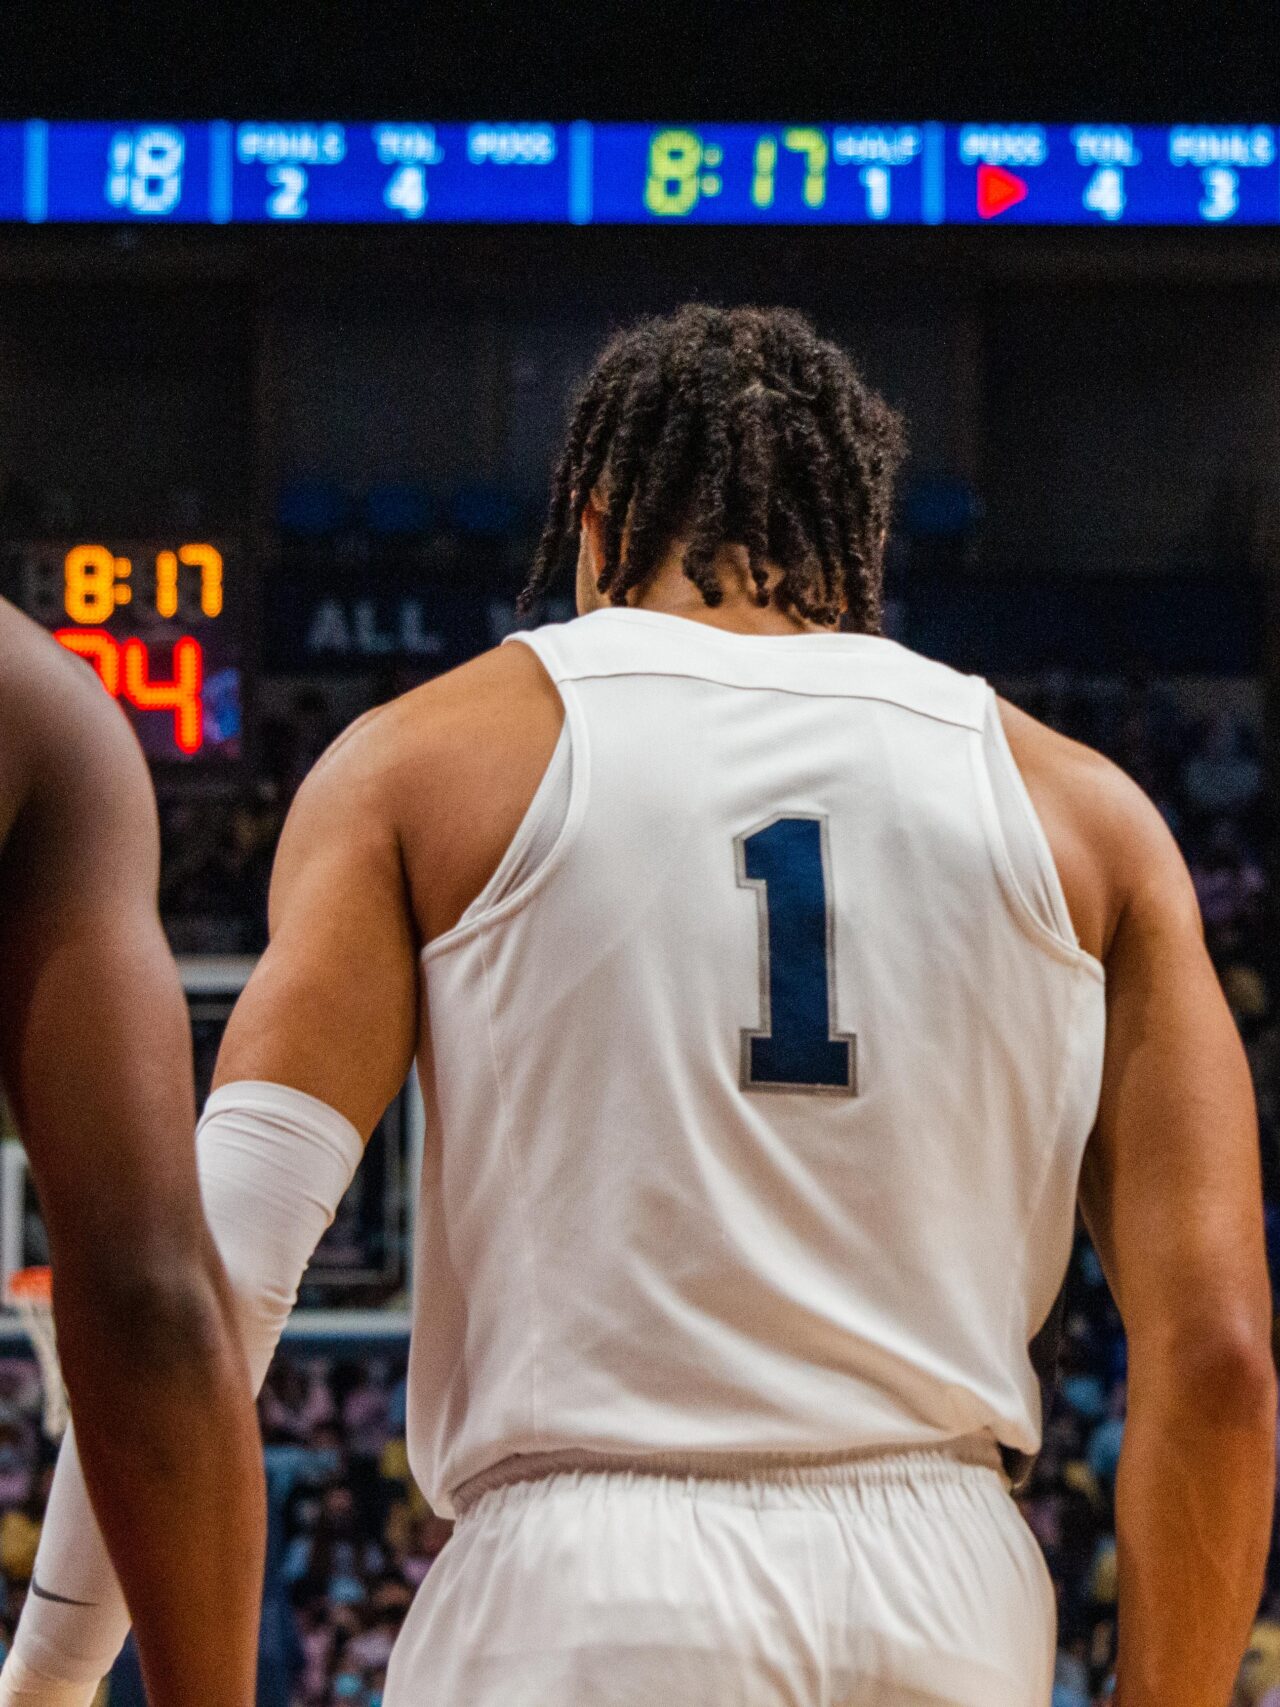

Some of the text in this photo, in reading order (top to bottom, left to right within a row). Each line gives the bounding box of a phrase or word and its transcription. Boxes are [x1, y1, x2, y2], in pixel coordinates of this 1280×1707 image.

[106, 125, 185, 215] 18
[266, 163, 308, 219] 2
[382, 163, 429, 219] 4
[644, 127, 828, 216] 8:17
[858, 164, 891, 219] 1
[1082, 164, 1126, 220] 4
[1199, 165, 1240, 220] 3
[64, 543, 223, 624] 8:17
[306, 597, 443, 655] ALL
[732, 811, 857, 1097] 1
